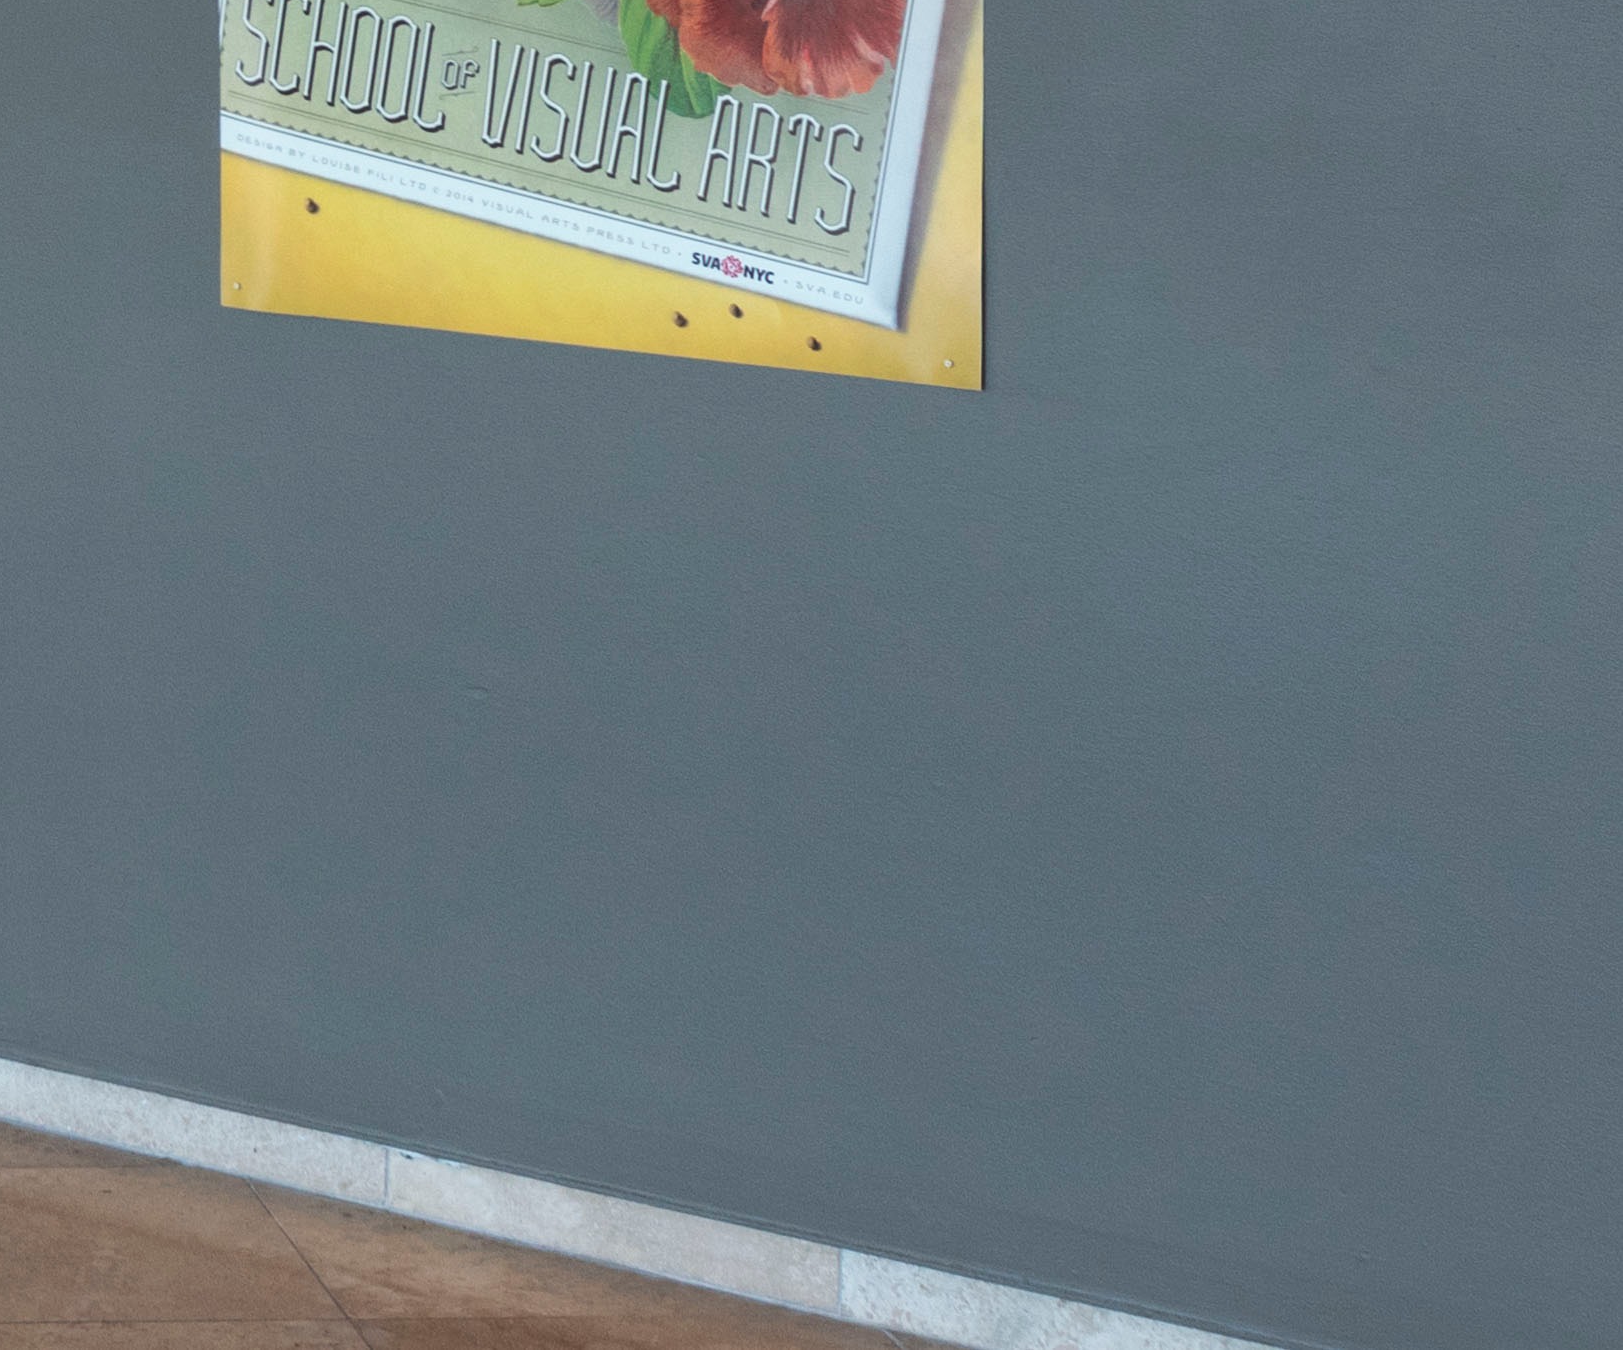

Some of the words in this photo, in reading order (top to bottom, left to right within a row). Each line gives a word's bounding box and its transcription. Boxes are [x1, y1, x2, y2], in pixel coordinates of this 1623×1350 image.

[288, 146, 306, 159] BY
[312, 156, 360, 175] LOUISE
[399, 178, 427, 191] LTD
[482, 199, 534, 220] VISUAL
[541, 216, 580, 232] ARTS
[586, 226, 634, 246] PRESS
[641, 241, 671, 255] LTD
[442, 57, 480, 92] OF
[481, 39, 681, 193] VISUAL
[699, 95, 863, 236] ARTS
